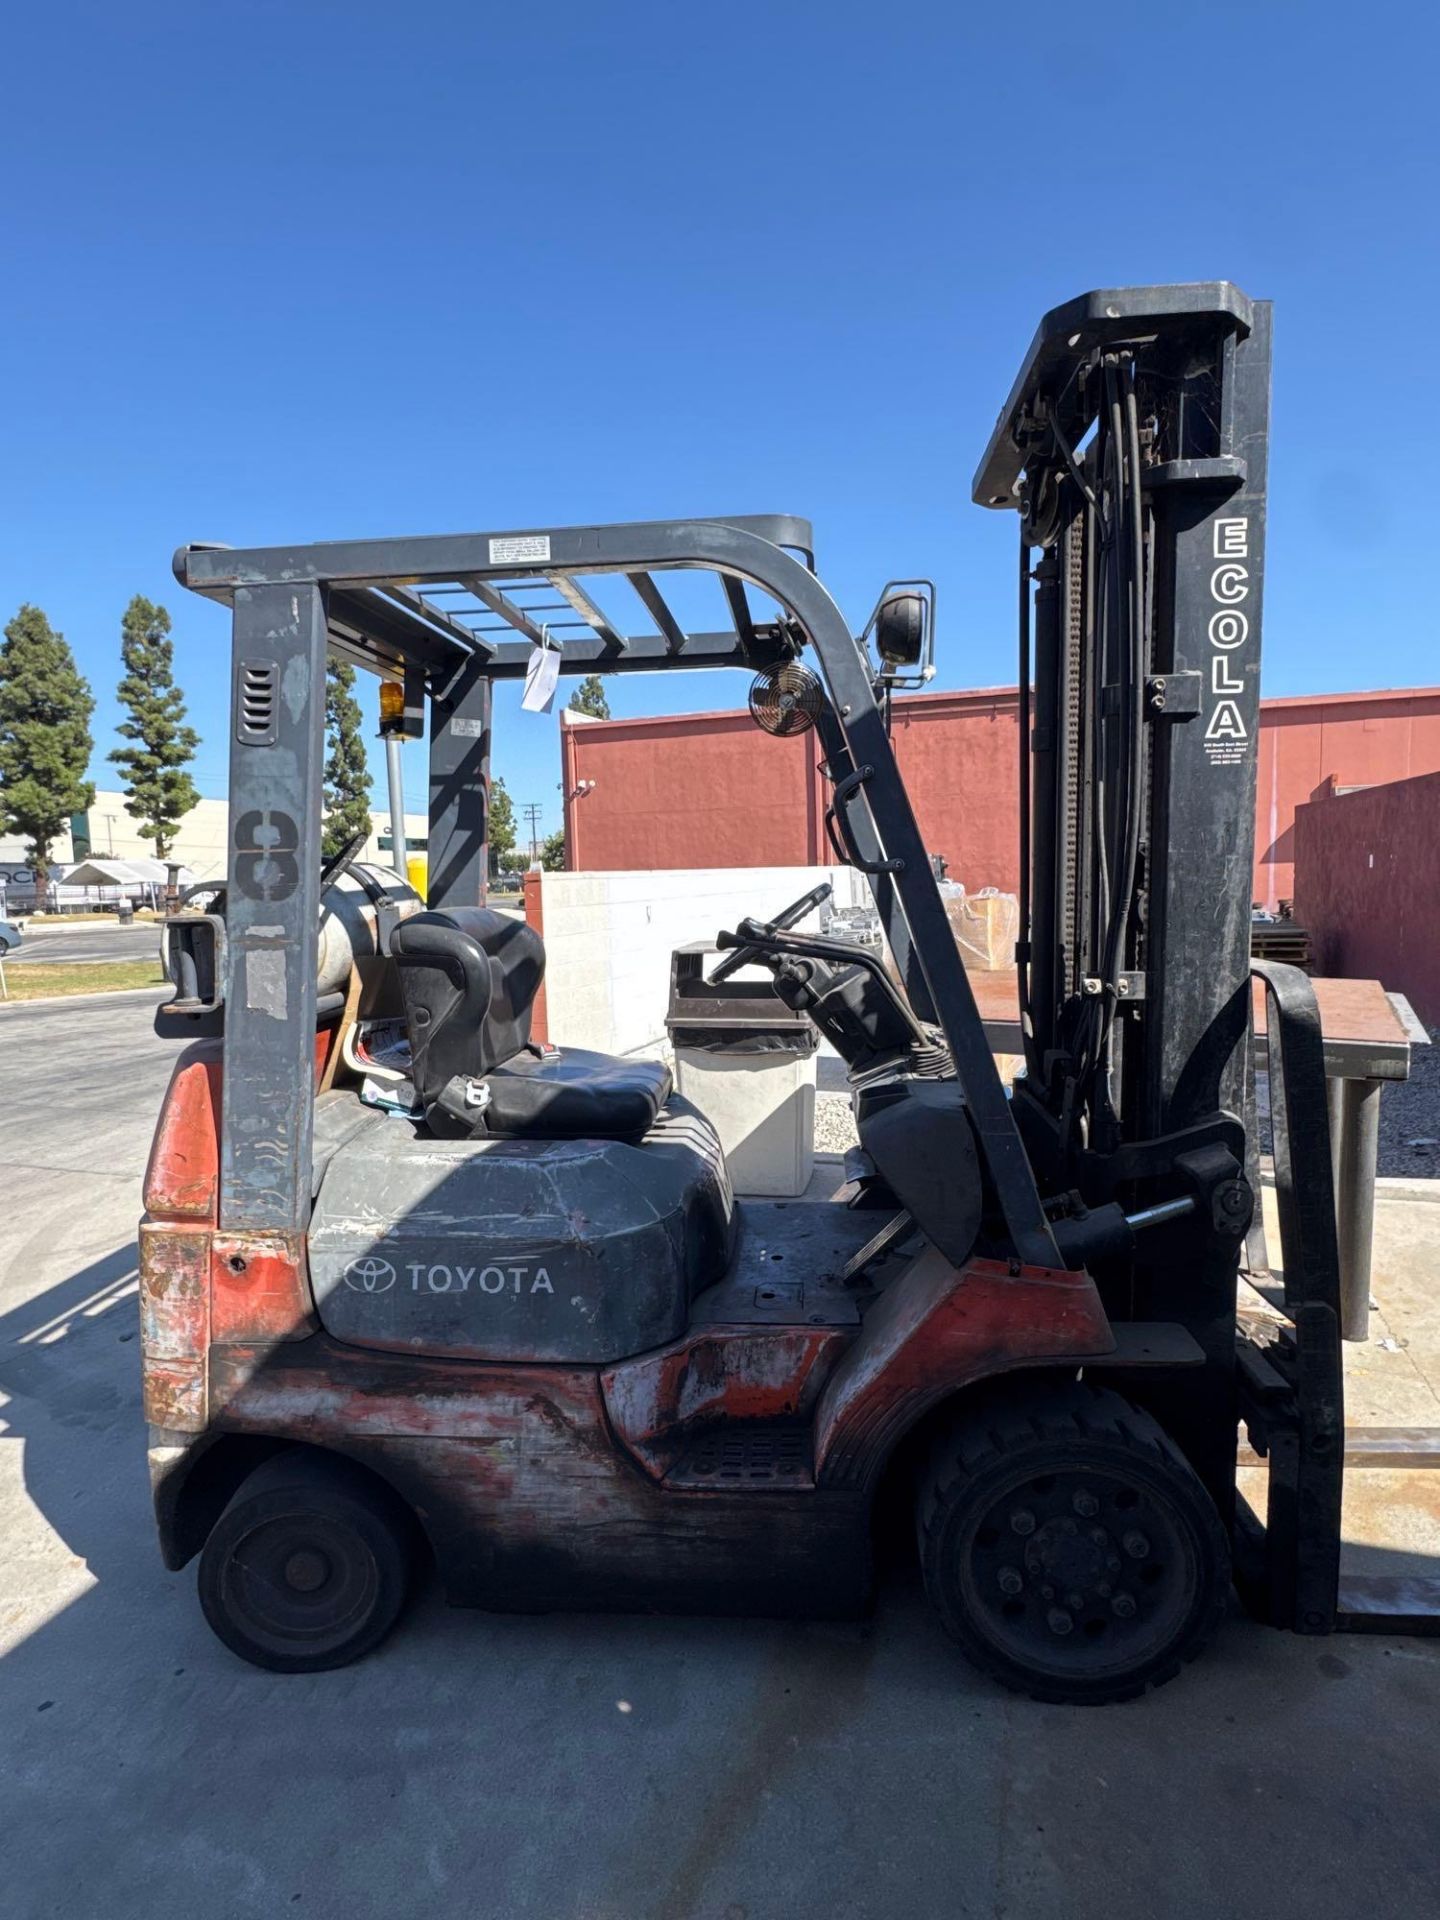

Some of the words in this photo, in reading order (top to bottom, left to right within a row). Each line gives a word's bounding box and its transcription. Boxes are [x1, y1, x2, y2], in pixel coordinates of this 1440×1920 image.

[1204, 517, 1249, 739] ECOLA
[235, 810, 299, 901] 8
[405, 1264, 554, 1294] TOYOTA
